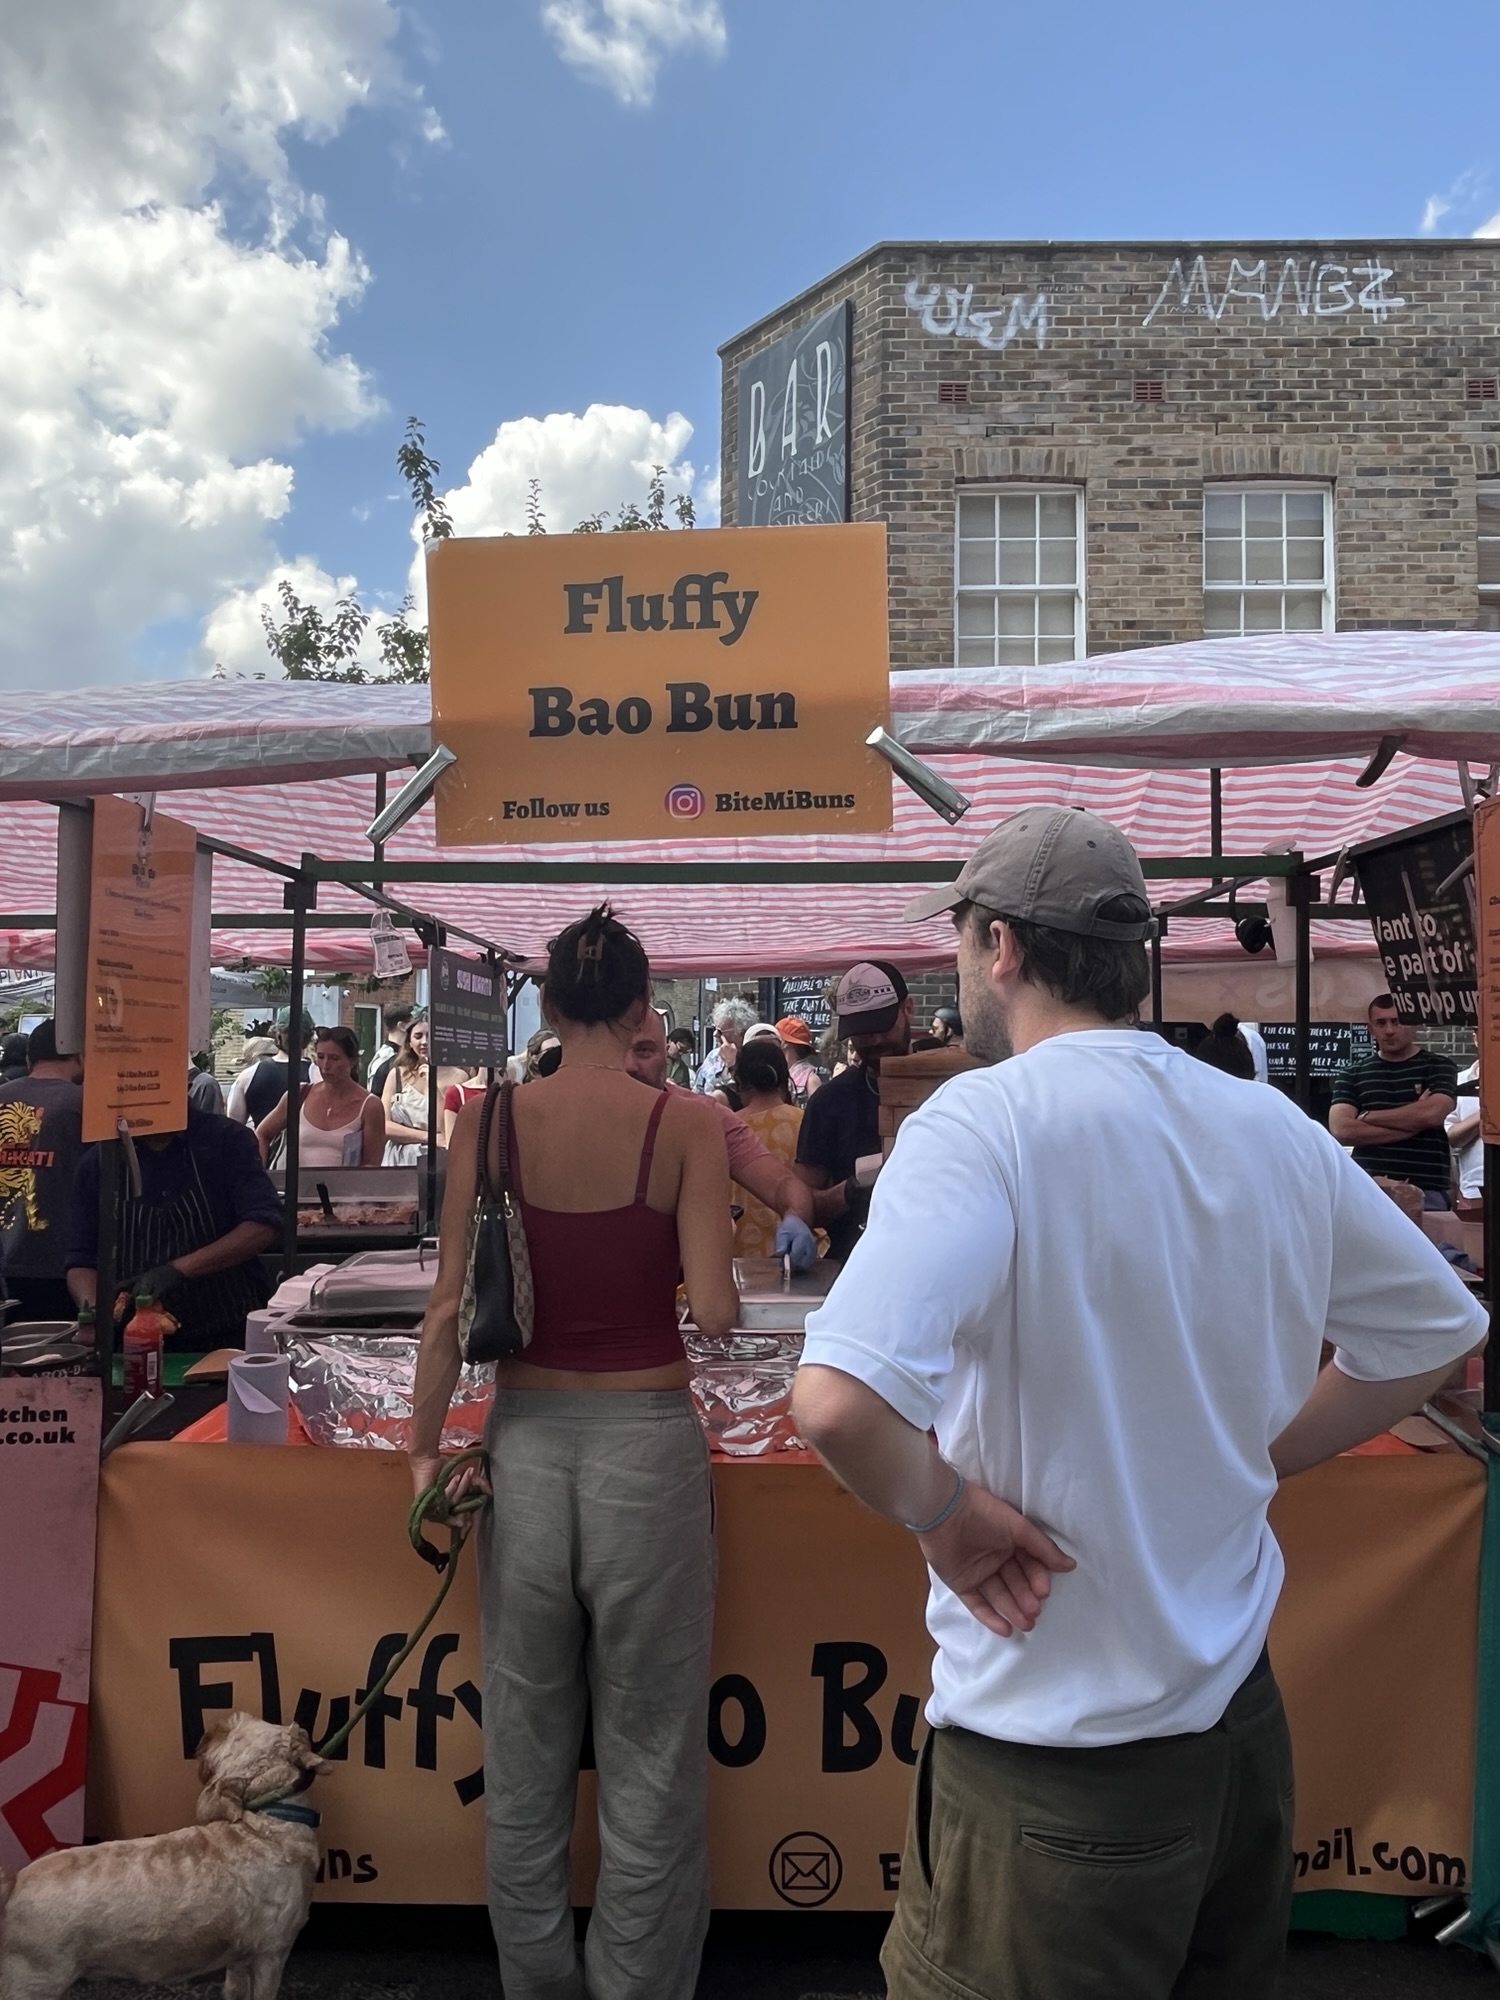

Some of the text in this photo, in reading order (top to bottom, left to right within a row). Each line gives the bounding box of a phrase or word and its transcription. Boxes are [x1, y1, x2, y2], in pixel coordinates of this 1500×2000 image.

[748, 340, 833, 479] BAR
[563, 571, 760, 647] Fluffy
[528, 682, 798, 738] Bao Bun
[502, 790, 855, 819] Follow us BiteMiBuns
[1399, 946, 1439, 981] pat
[1442, 941, 1463, 973] of
[0, 1406, 67, 1423] tchen
[0, 1426, 76, 1444] .co.uk
